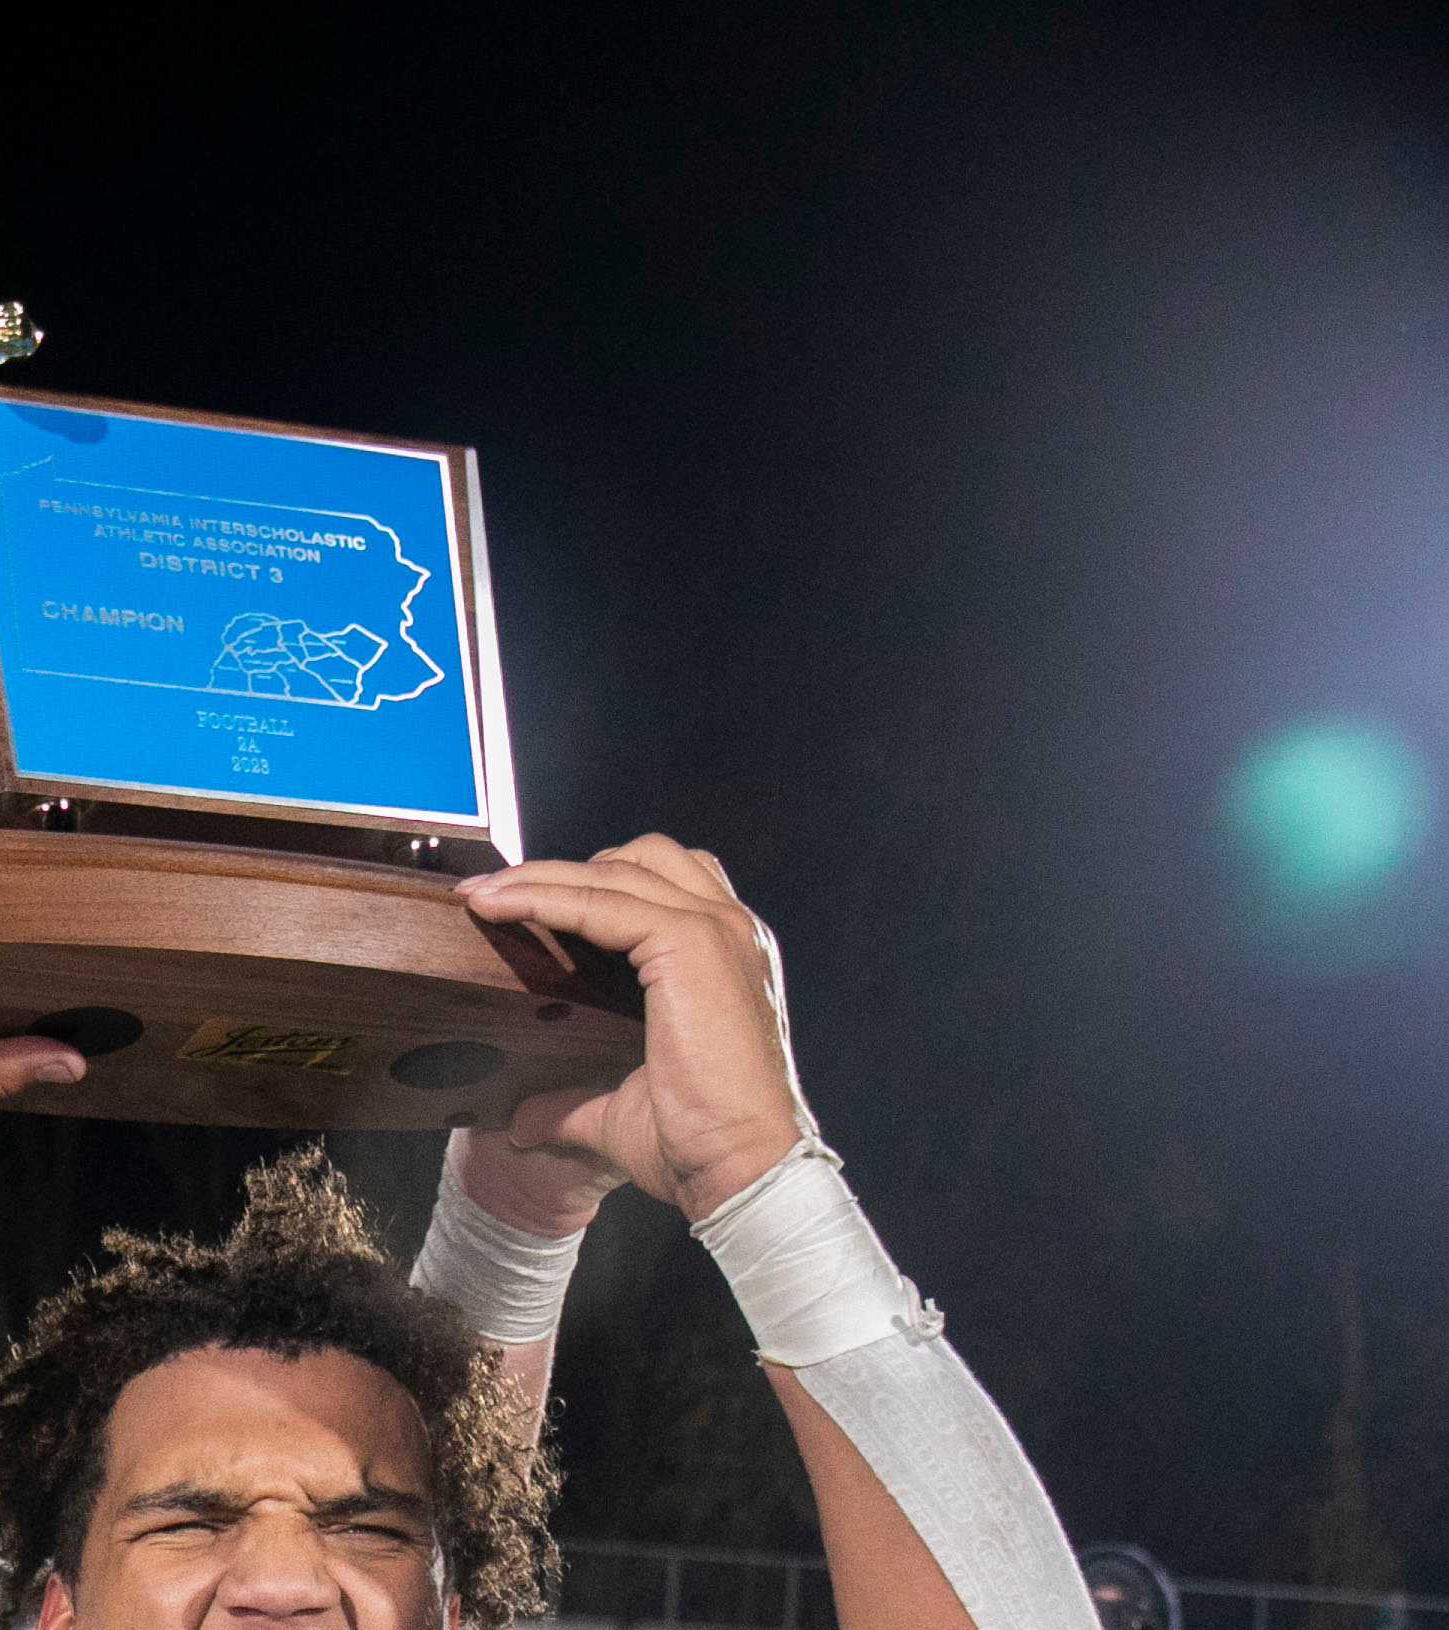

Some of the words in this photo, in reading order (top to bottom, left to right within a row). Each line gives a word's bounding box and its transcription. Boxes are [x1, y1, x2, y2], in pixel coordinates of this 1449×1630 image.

[37, 499, 184, 530] PENNSYLVANIA
[189, 517, 367, 552] INTERSCHOLASTIC
[94, 524, 186, 548] ATHLETIC
[192, 535, 321, 564] ASSOCIATION
[139, 551, 261, 581] DISTRICT
[268, 566, 284, 584] 3
[41, 600, 185, 634] CHAMPION
[196, 710, 295, 737] FOOTBALL
